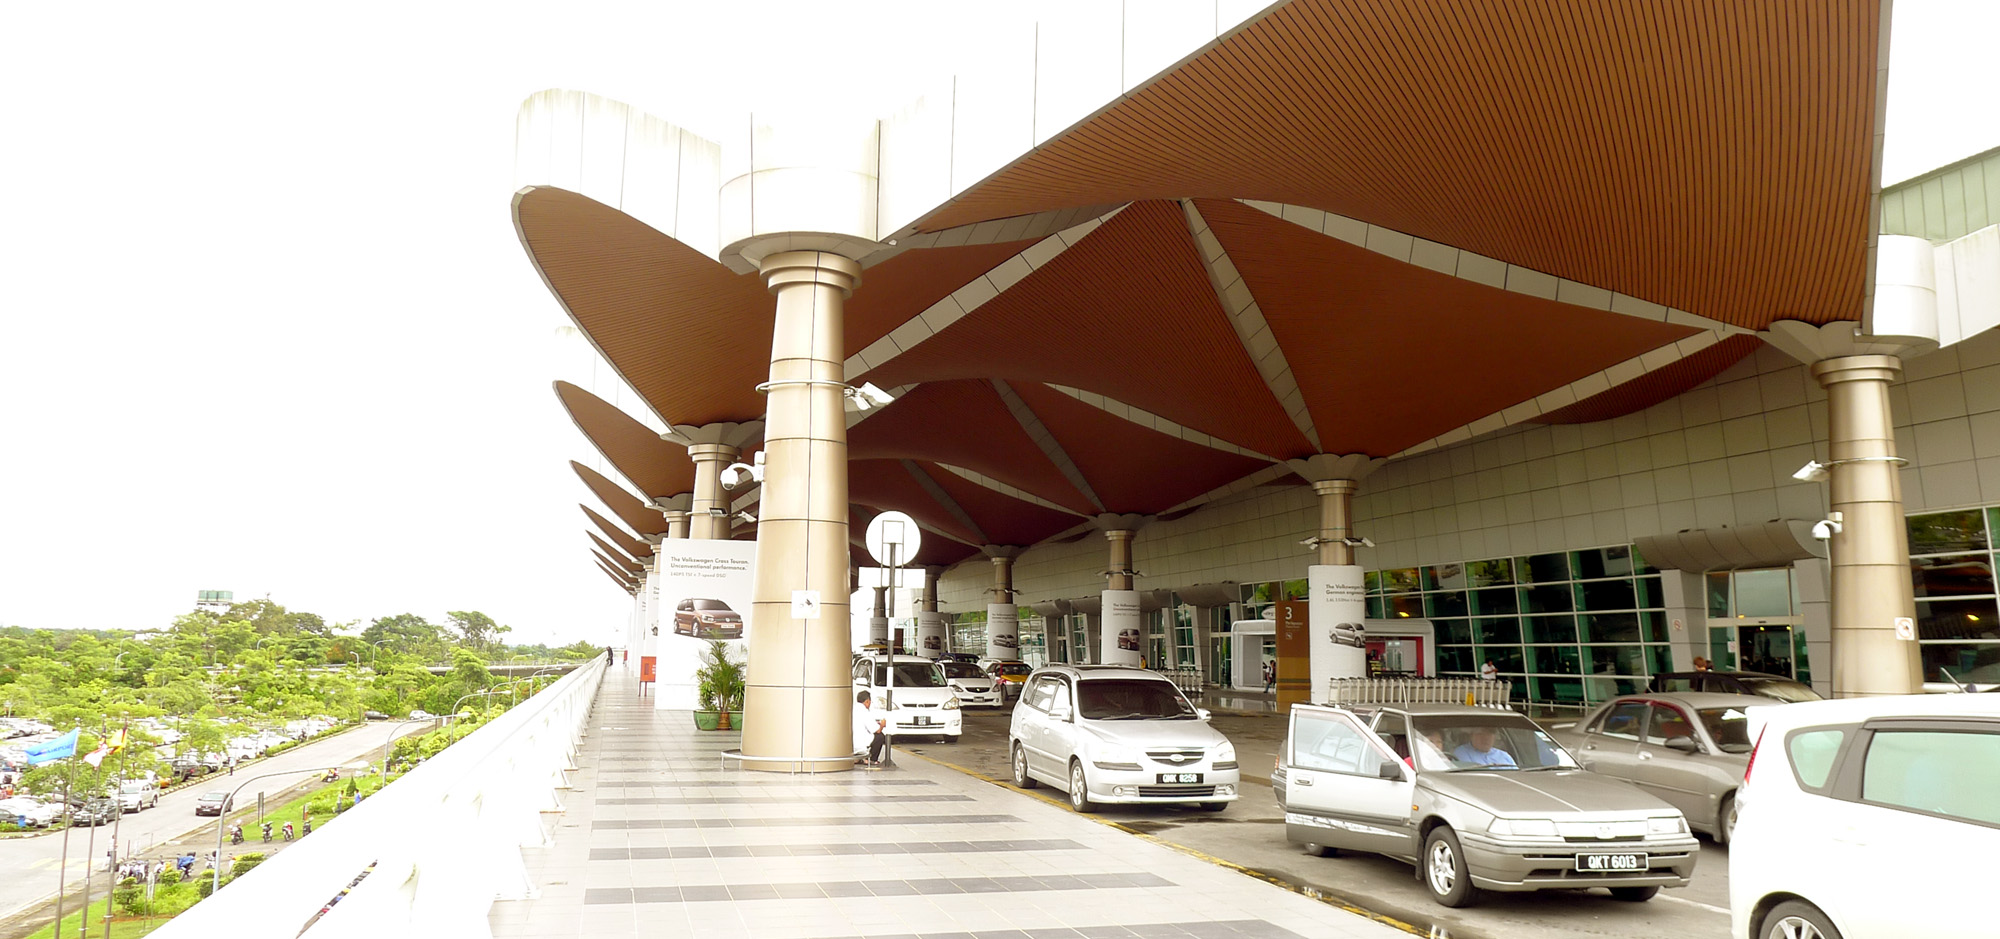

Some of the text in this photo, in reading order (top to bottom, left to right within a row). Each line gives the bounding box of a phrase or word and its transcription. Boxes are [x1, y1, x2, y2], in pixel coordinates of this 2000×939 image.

[1285, 606, 1292, 620] 3
[1588, 855, 1637, 869] QKT 6013
